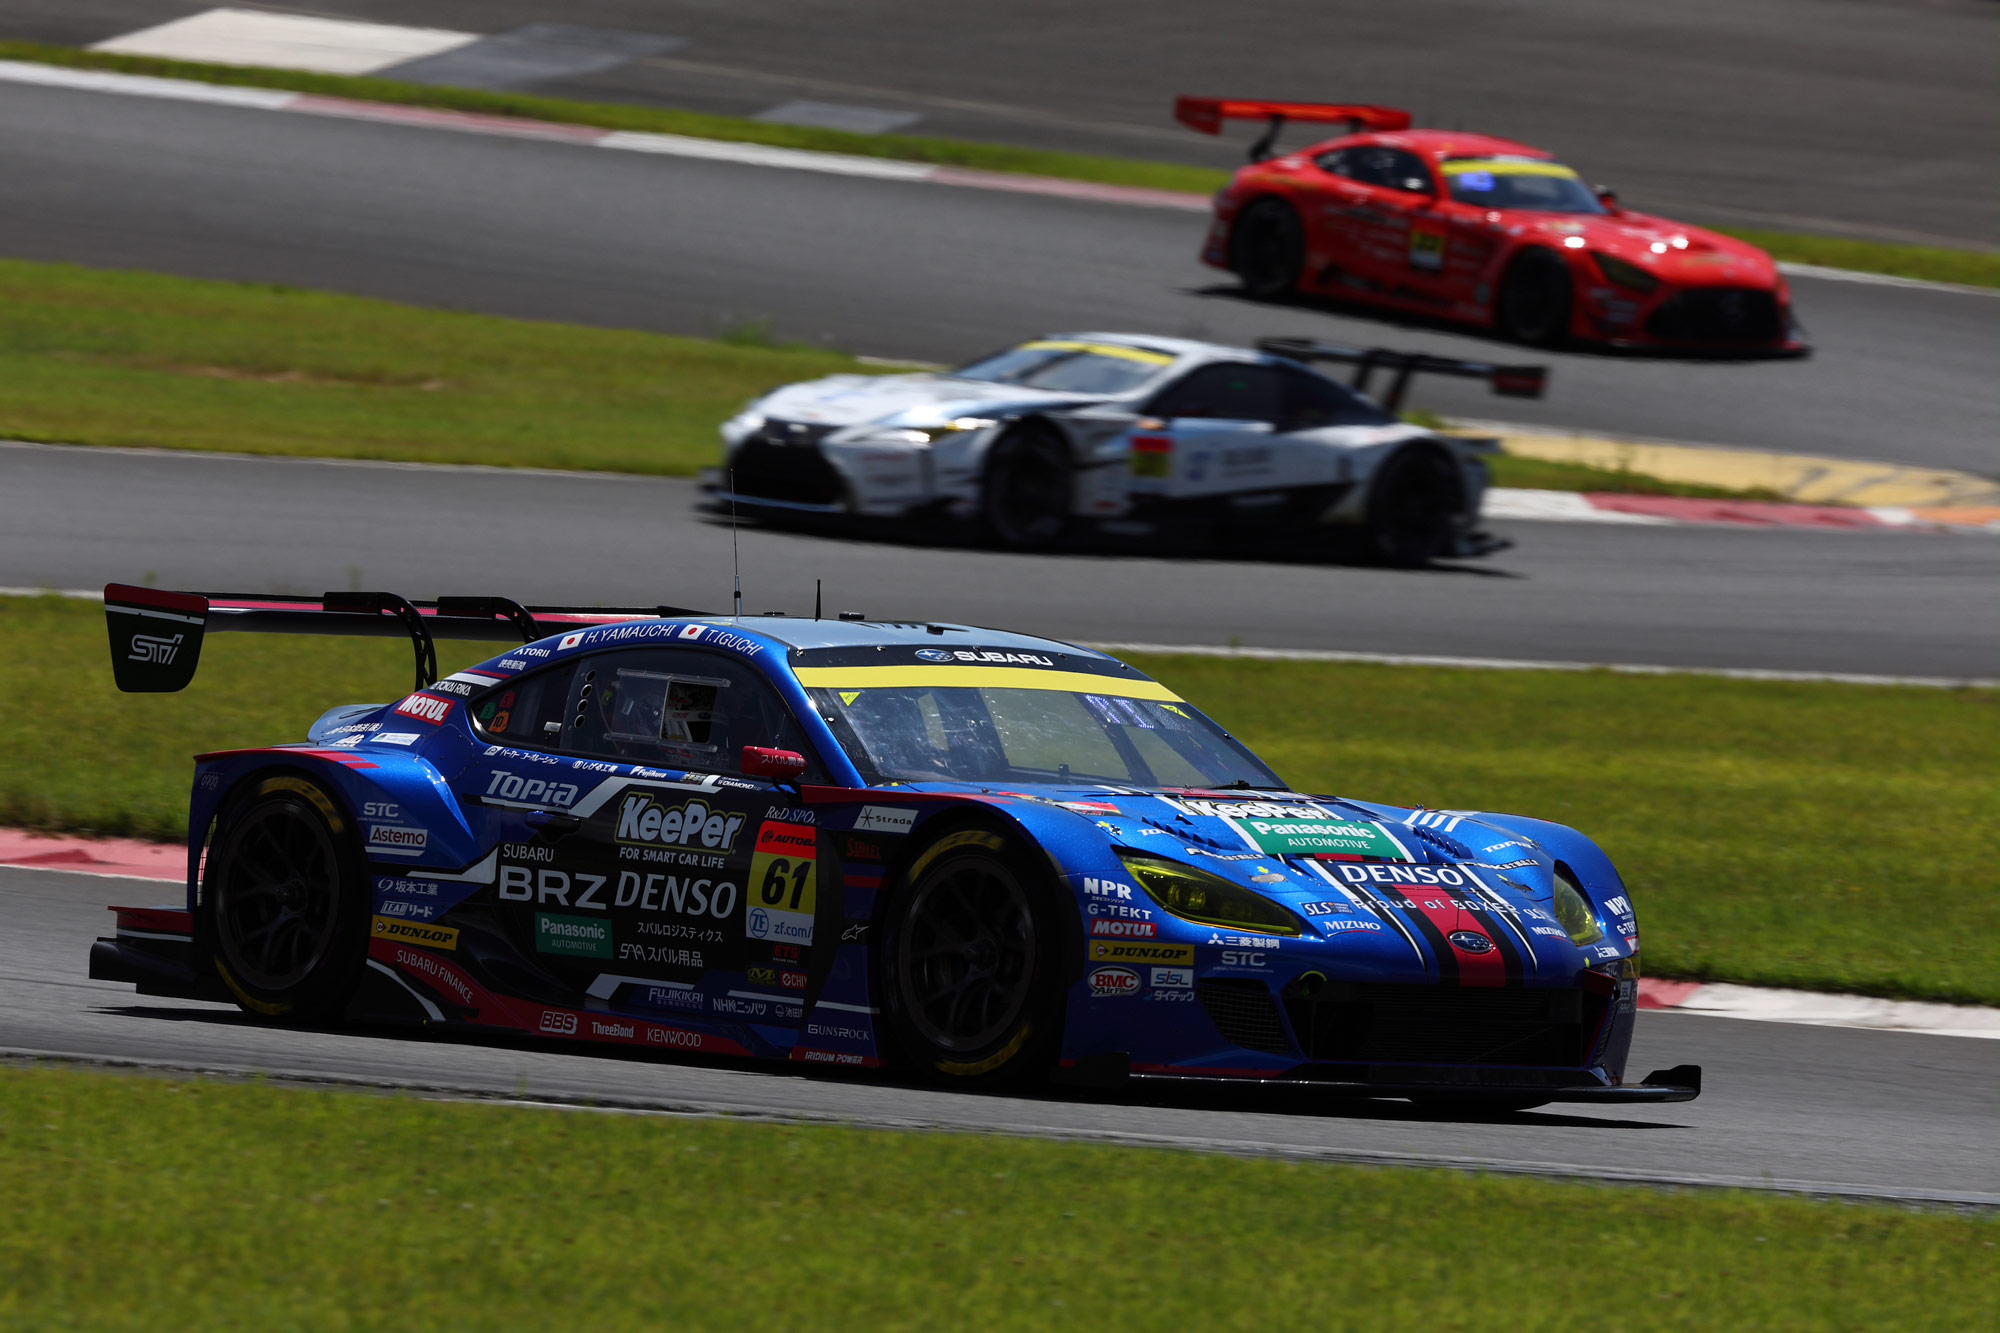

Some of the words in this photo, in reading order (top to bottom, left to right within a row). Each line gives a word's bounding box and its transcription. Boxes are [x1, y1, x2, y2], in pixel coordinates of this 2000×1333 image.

[584, 624, 678, 645] H.YAMAUCHI
[705, 629, 764, 657] T.IGUCHI
[953, 650, 1053, 667] SUBARU
[397, 694, 449, 722] MOTUL
[493, 715, 504, 728] 10
[638, 768, 667, 779] Fujikura
[363, 802, 399, 818] STC
[764, 805, 790, 820] R&D
[616, 795, 746, 850] KeePer
[876, 815, 912, 826] Strada
[371, 827, 425, 846] Astemo
[1250, 821, 1376, 840] Panasonic
[1287, 837, 1371, 850] AUTOMOTIVE
[503, 843, 555, 863] SUBARU
[619, 847, 639, 861] FOR
[642, 848, 676, 864] SMART
[678, 851, 699, 866] CAR
[701, 854, 725, 870] LIFE
[761, 857, 812, 910] 61
[1338, 865, 1464, 886] DENSO
[395, 880, 439, 896] 坂本工業
[498, 864, 608, 911] BRZ
[614, 870, 737, 920] DENSO
[1083, 877, 1133, 900] NPR
[384, 901, 406, 914] LEAD
[409, 903, 434, 918] リード
[1087, 903, 1153, 920] G-TEKT
[1304, 902, 1332, 916] SLS
[1424, 898, 1446, 910] of
[1449, 899, 1520, 916] BOXER
[1604, 896, 1632, 916] NPR
[540, 918, 606, 940] Panasonic
[751, 913, 768, 933] ZF
[1092, 921, 1154, 937] MOTUL
[1324, 920, 1382, 931] MIZUHO
[388, 924, 453, 943] DUNLOP
[637, 922, 724, 943] スバルロジスティクス
[552, 938, 597, 953] AUTOMOTIVE
[1110, 946, 1188, 959] DUNLOP
[648, 947, 704, 968] スバル用品
[1221, 951, 1267, 967] STC
[396, 949, 438, 976] SUBARU
[437, 965, 474, 1005] FINANCE
[1095, 974, 1135, 988] BMC
[648, 987, 704, 1003] FUJIKIKAI
[1153, 990, 1195, 1002] ダイテック
[539, 1010, 578, 1036] BBS
[591, 1021, 635, 1039] ThreeBond
[646, 1028, 702, 1048] KENWOOD
[804, 1051, 836, 1062] IRIDIUM
[835, 1054, 864, 1065] POWER
